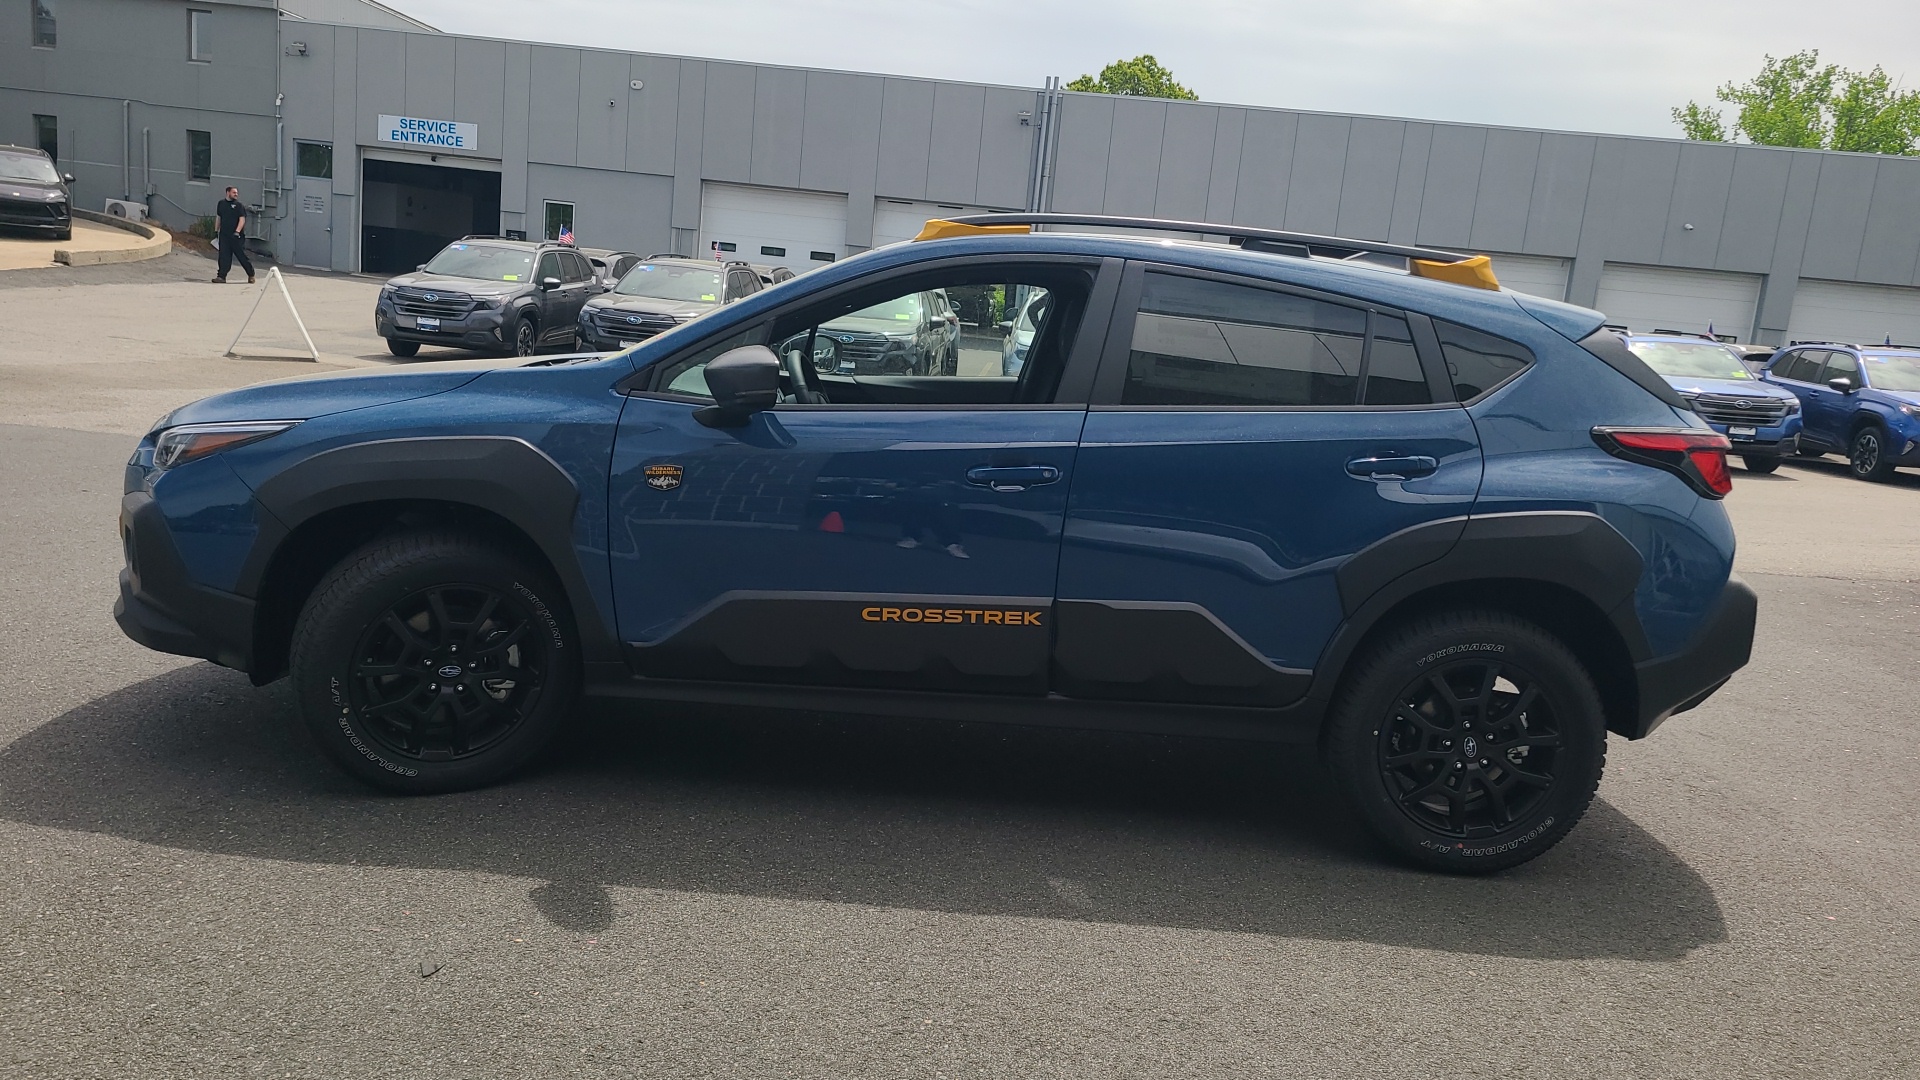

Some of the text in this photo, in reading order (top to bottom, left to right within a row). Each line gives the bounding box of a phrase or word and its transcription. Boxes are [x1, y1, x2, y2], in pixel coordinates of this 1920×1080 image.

[400, 118, 457, 134] SERVICE
[391, 130, 464, 147] ENTRANCE
[513, 581, 564, 649] YOKOHAMA
[861, 607, 1042, 626] CROSSTREK
[1417, 643, 1505, 667] YOKOHAMA
[330, 676, 419, 777] GEOLANDAR A/T
[1420, 815, 1555, 857] GEOLANDAR A/T
